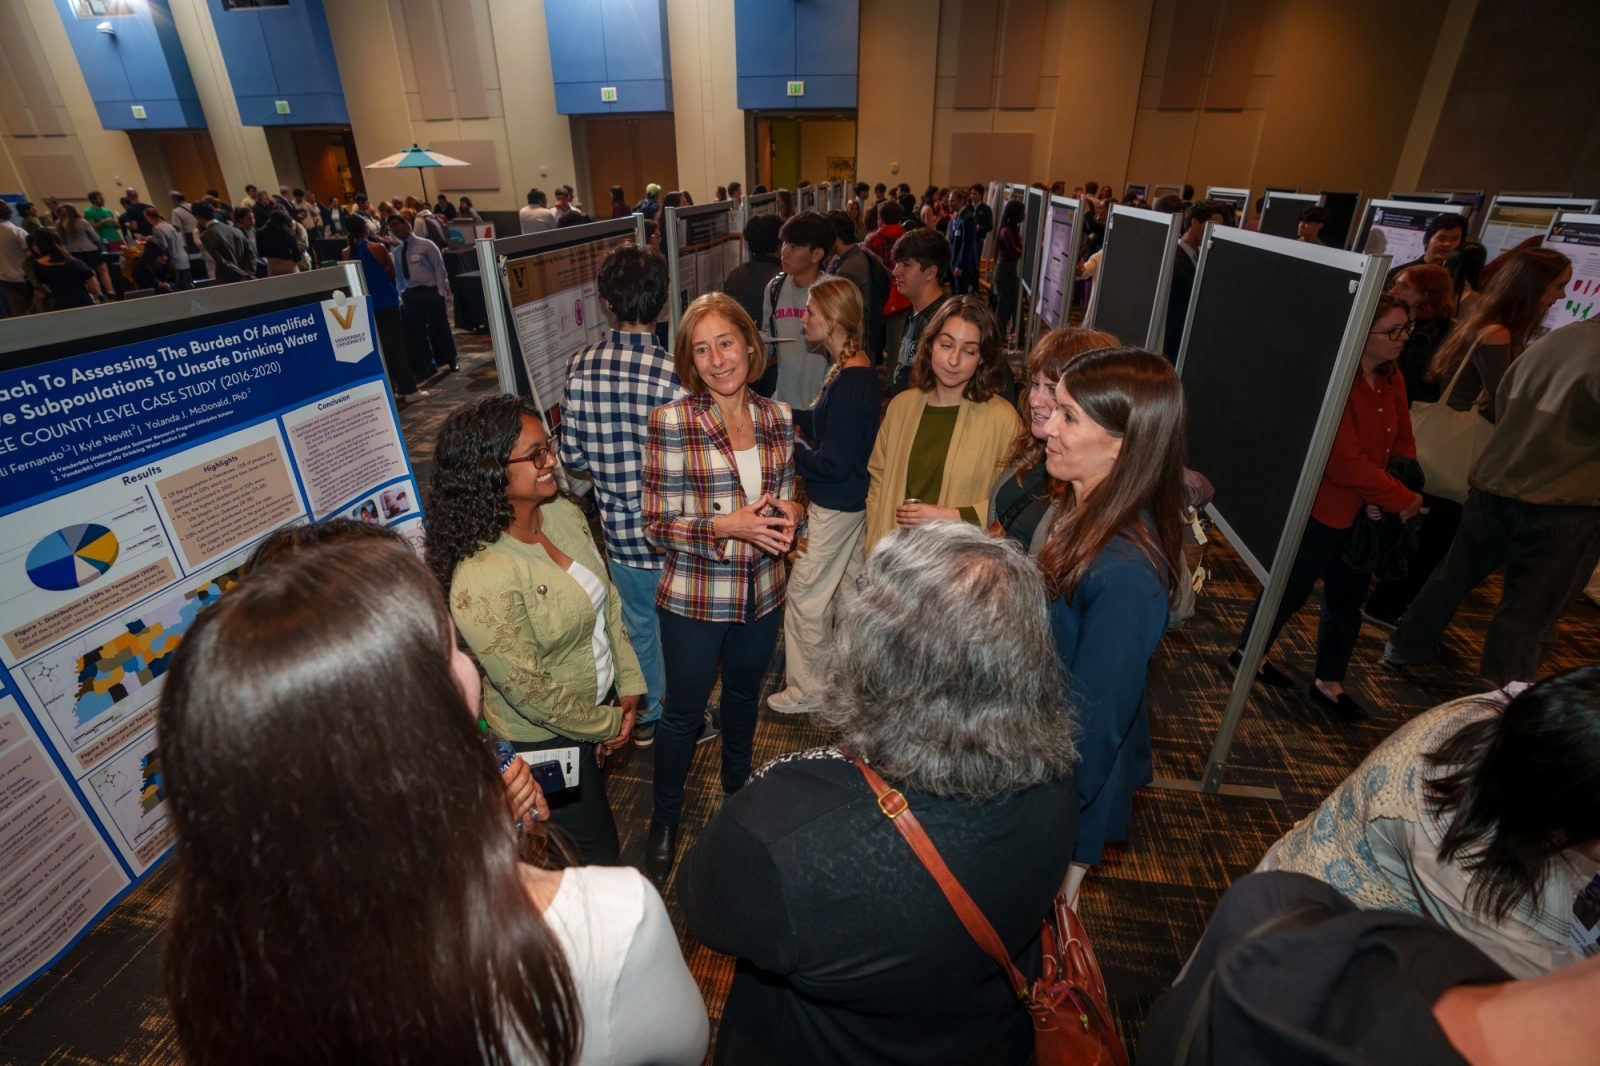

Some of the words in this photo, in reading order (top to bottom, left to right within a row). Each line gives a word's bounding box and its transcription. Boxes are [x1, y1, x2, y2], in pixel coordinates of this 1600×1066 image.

[330, 304, 356, 330] V
[38, 374, 67, 391] To
[71, 356, 158, 384] Assessing
[157, 346, 188, 362] The
[189, 335, 240, 355] Burden
[243, 327, 259, 342] Of
[261, 314, 315, 337] Amplified
[20, 377, 154, 420] Subpoulations
[154, 369, 176, 384] To
[178, 358, 230, 378] Unsafe
[233, 343, 284, 364] Drinking
[284, 332, 318, 349] Water
[20, 402, 139, 446] COUNTY-LEVEL
[141, 391, 178, 411] CASE
[178, 380, 217, 401] STUDY
[220, 361, 282, 391] (2016-2020)
[317, 394, 351, 411] Conclusion
[79, 438, 102, 453] Kyle
[144, 415, 181, 431] Yolanda
[181, 410, 189, 420] J.
[189, 397, 231, 416] McDonald,
[56, 458, 89, 473] Vanderbilt
[90, 444, 131, 462] Undergraduate
[131, 437, 153, 447] Summer
[153, 429, 175, 440] Research
[61, 464, 94, 479] Vanderbilt
[93, 454, 122, 468] University
[122, 446, 146, 458] Drinking
[203, 455, 239, 474] Highlights
[122, 466, 162, 486] Results
